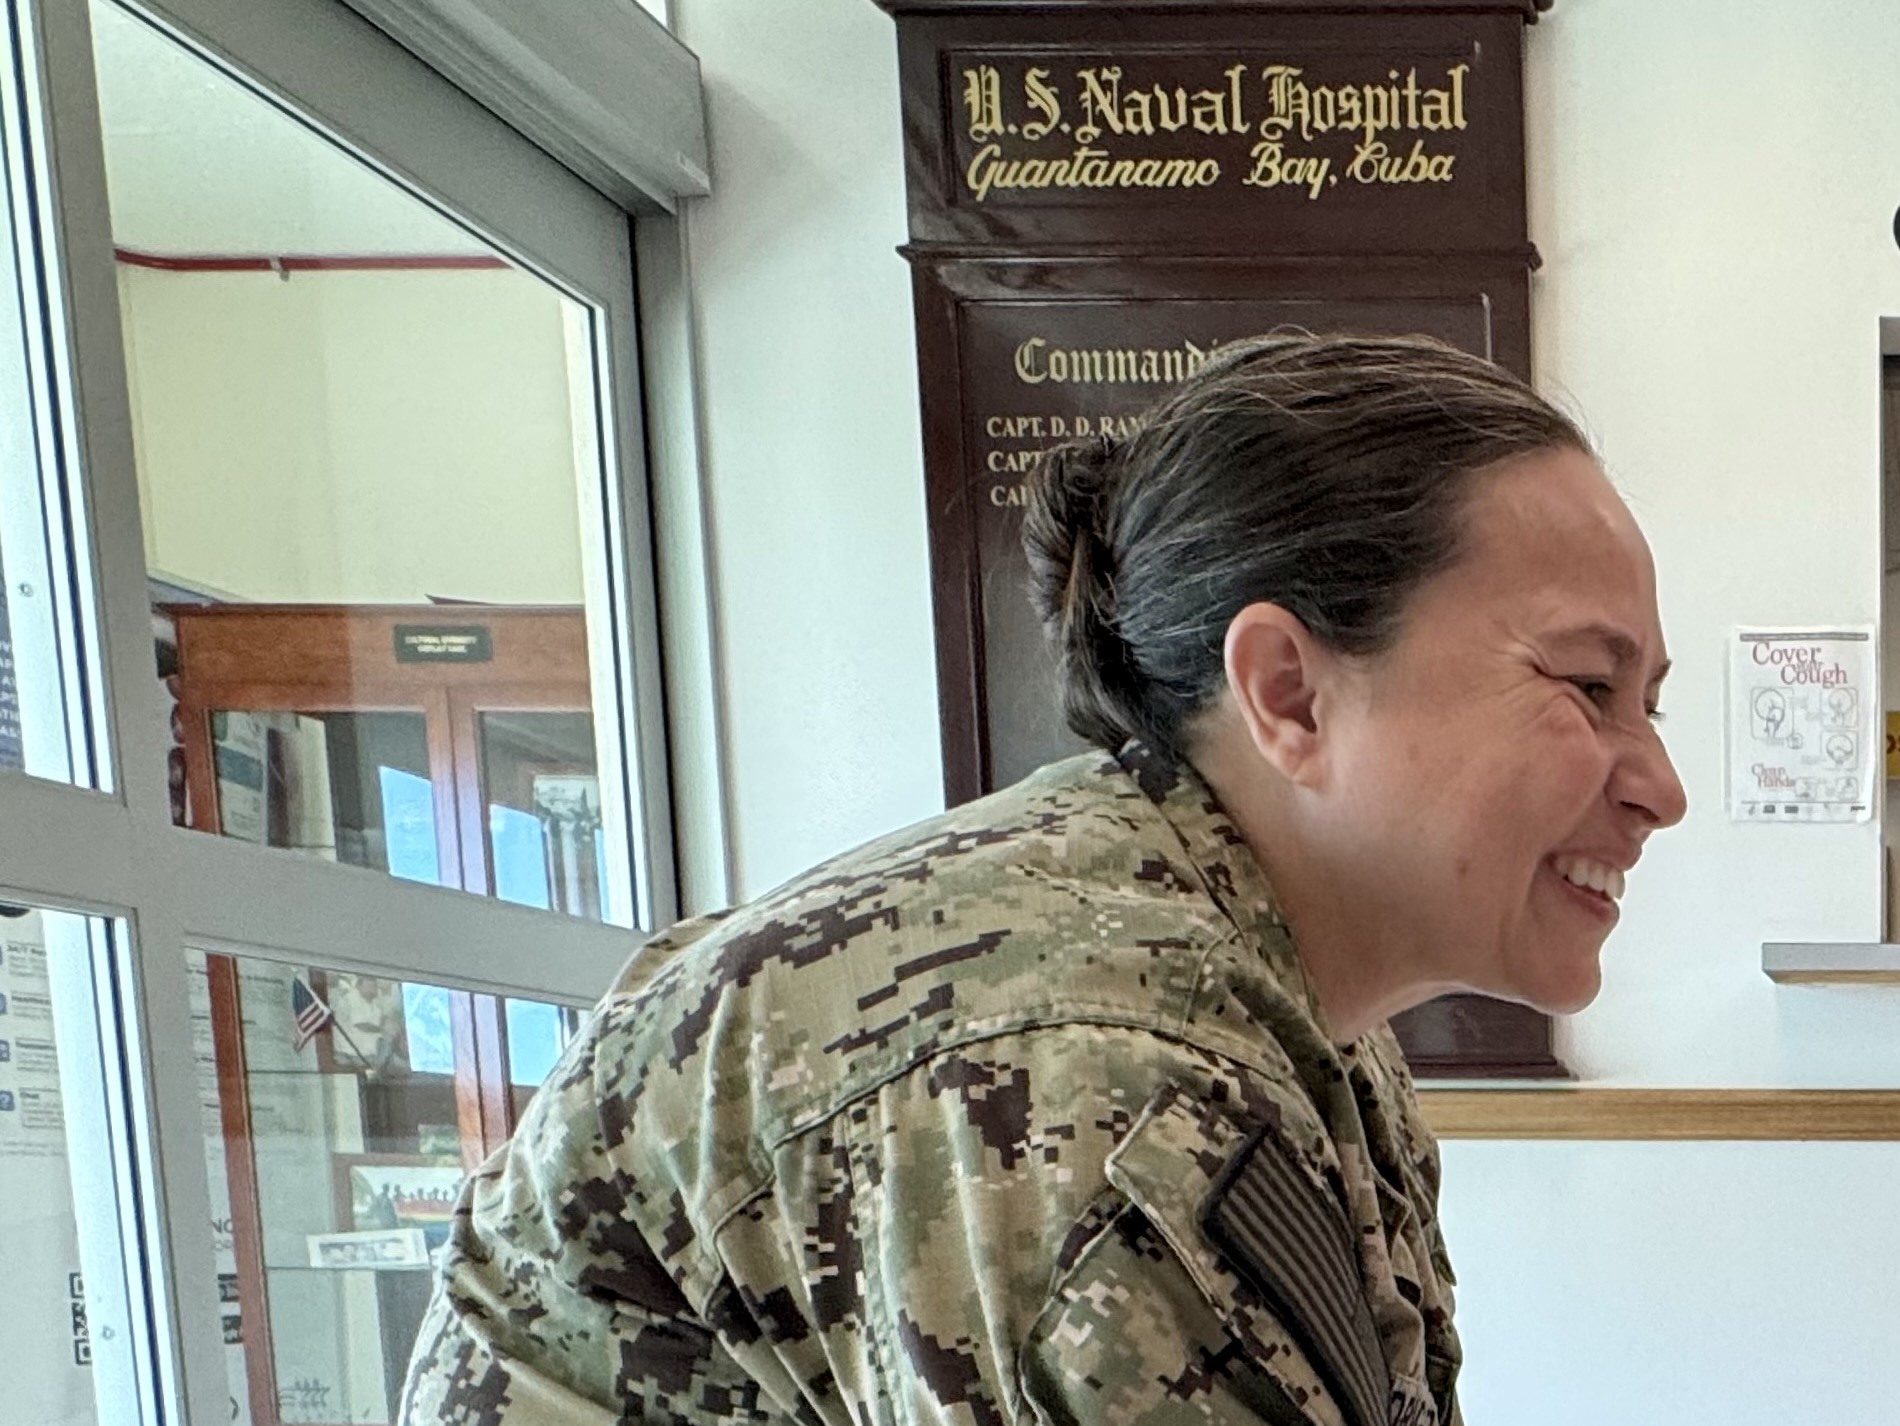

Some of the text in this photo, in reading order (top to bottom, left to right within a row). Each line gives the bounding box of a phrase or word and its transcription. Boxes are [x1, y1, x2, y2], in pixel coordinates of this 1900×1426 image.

[1072, 64, 1249, 143] Naval
[1260, 64, 1470, 144] Hospital
[967, 140, 1456, 201] Guantanamo Bay, Cuba
[986, 416, 1047, 438] CAPT.
[1051, 416, 1071, 438] D.
[1076, 416, 1095, 438] D.
[1752, 640, 1822, 665] Cover
[1780, 663, 1848, 689] Cough
